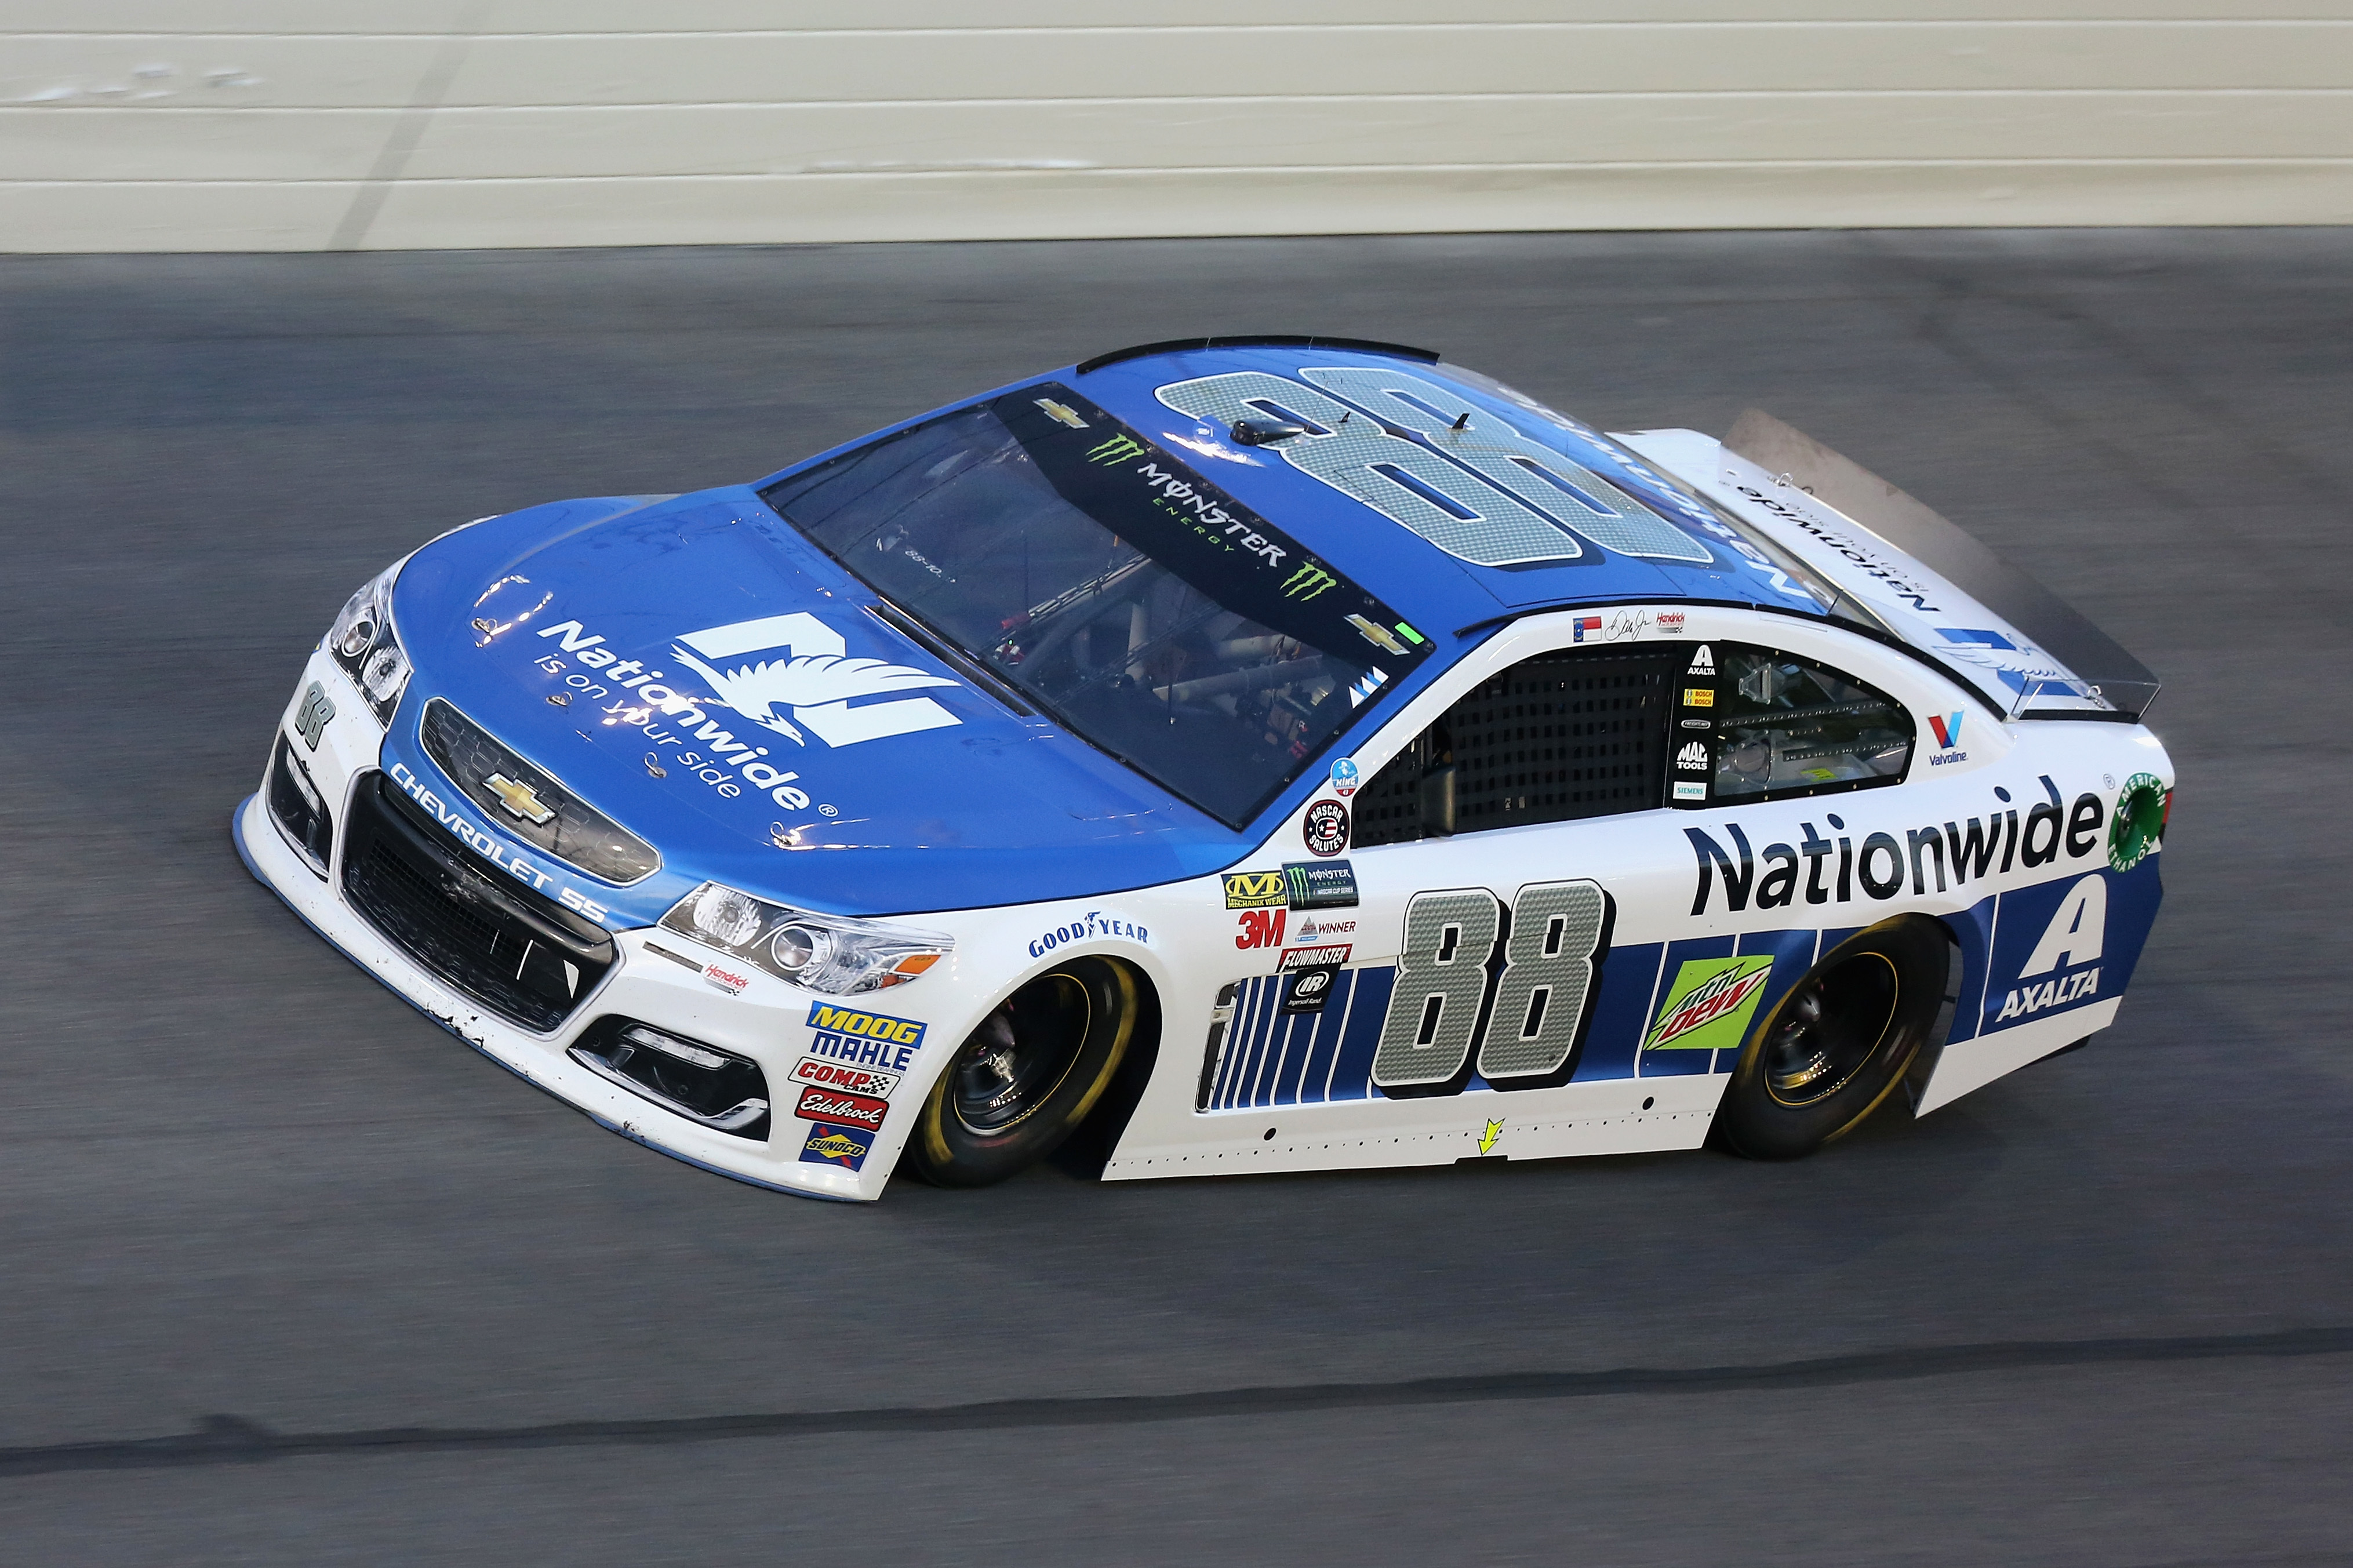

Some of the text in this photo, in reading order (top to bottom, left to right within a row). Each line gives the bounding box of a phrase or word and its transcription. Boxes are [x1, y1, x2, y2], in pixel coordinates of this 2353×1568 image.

[1151, 496, 1235, 553] ENERGY
[1736, 485, 1942, 612] Nationwide
[1656, 612, 1685, 626] Hendrick
[1688, 667, 1716, 676] AXALTA
[294, 679, 336, 752] 88
[533, 652, 741, 799] is on your side
[536, 619, 811, 811] Nationwide
[1676, 741, 1708, 762] MAC
[1929, 751, 1967, 766] Valvoline
[1676, 761, 1708, 770] TOOLS
[1336, 777, 1356, 787] KING
[2116, 774, 2167, 817] AMERICAN
[1310, 805, 1344, 824] NASCAR
[390, 762, 610, 923] CHEVROLET SS
[1309, 834, 1344, 852] SALUTES
[1682, 774, 2104, 916] Nationwide
[2108, 840, 2154, 872] ETHANOL
[1227, 894, 1286, 908] MECHANIX WEAR
[1235, 909, 1286, 949] 3M
[1318, 921, 1356, 934] WINNER
[1279, 946, 1347, 973] FLOWMASTER
[705, 963, 749, 988] Hendrick
[1299, 976, 1325, 992] IR
[1370, 879, 1609, 1086] 88
[1288, 998, 1310, 1007] Ingersoll
[1995, 966, 2100, 1023] AXALTA
[811, 1006, 923, 1044] MOOG
[810, 1031, 914, 1072] MAHLE
[798, 1062, 871, 1086] COMP
[843, 1084, 879, 1095] CAMS
[800, 1094, 883, 1123] Edelbrock
[808, 1138, 864, 1156] SUNOCO
